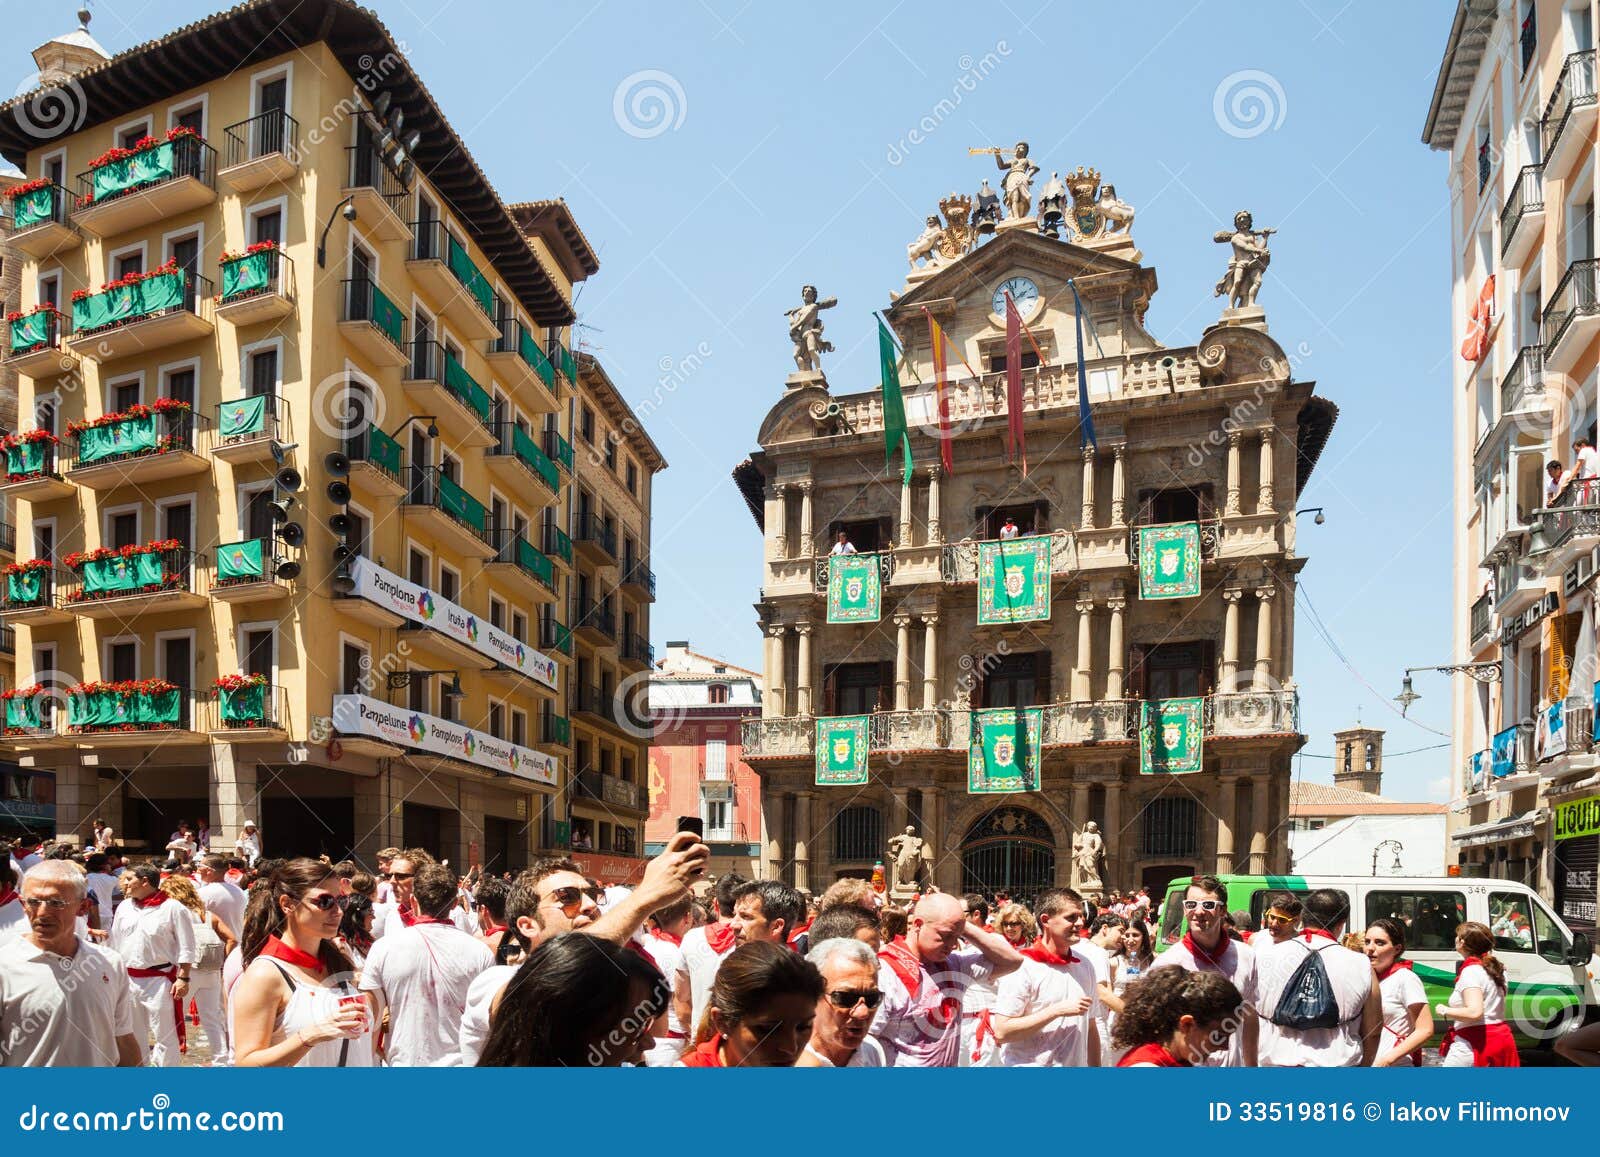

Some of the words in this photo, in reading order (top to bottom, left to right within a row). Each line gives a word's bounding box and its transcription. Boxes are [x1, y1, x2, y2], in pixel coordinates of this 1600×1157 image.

[374, 572, 416, 605] Pamplona
[447, 608, 466, 630] Iruña
[488, 631, 515, 657] Pamplona
[1502, 591, 1559, 646] AGENCIA
[359, 703, 408, 731] Pampelune
[431, 724, 464, 746] Pamplona
[521, 754, 545, 771] Pamplona
[1467, 886, 1487, 895] 346
